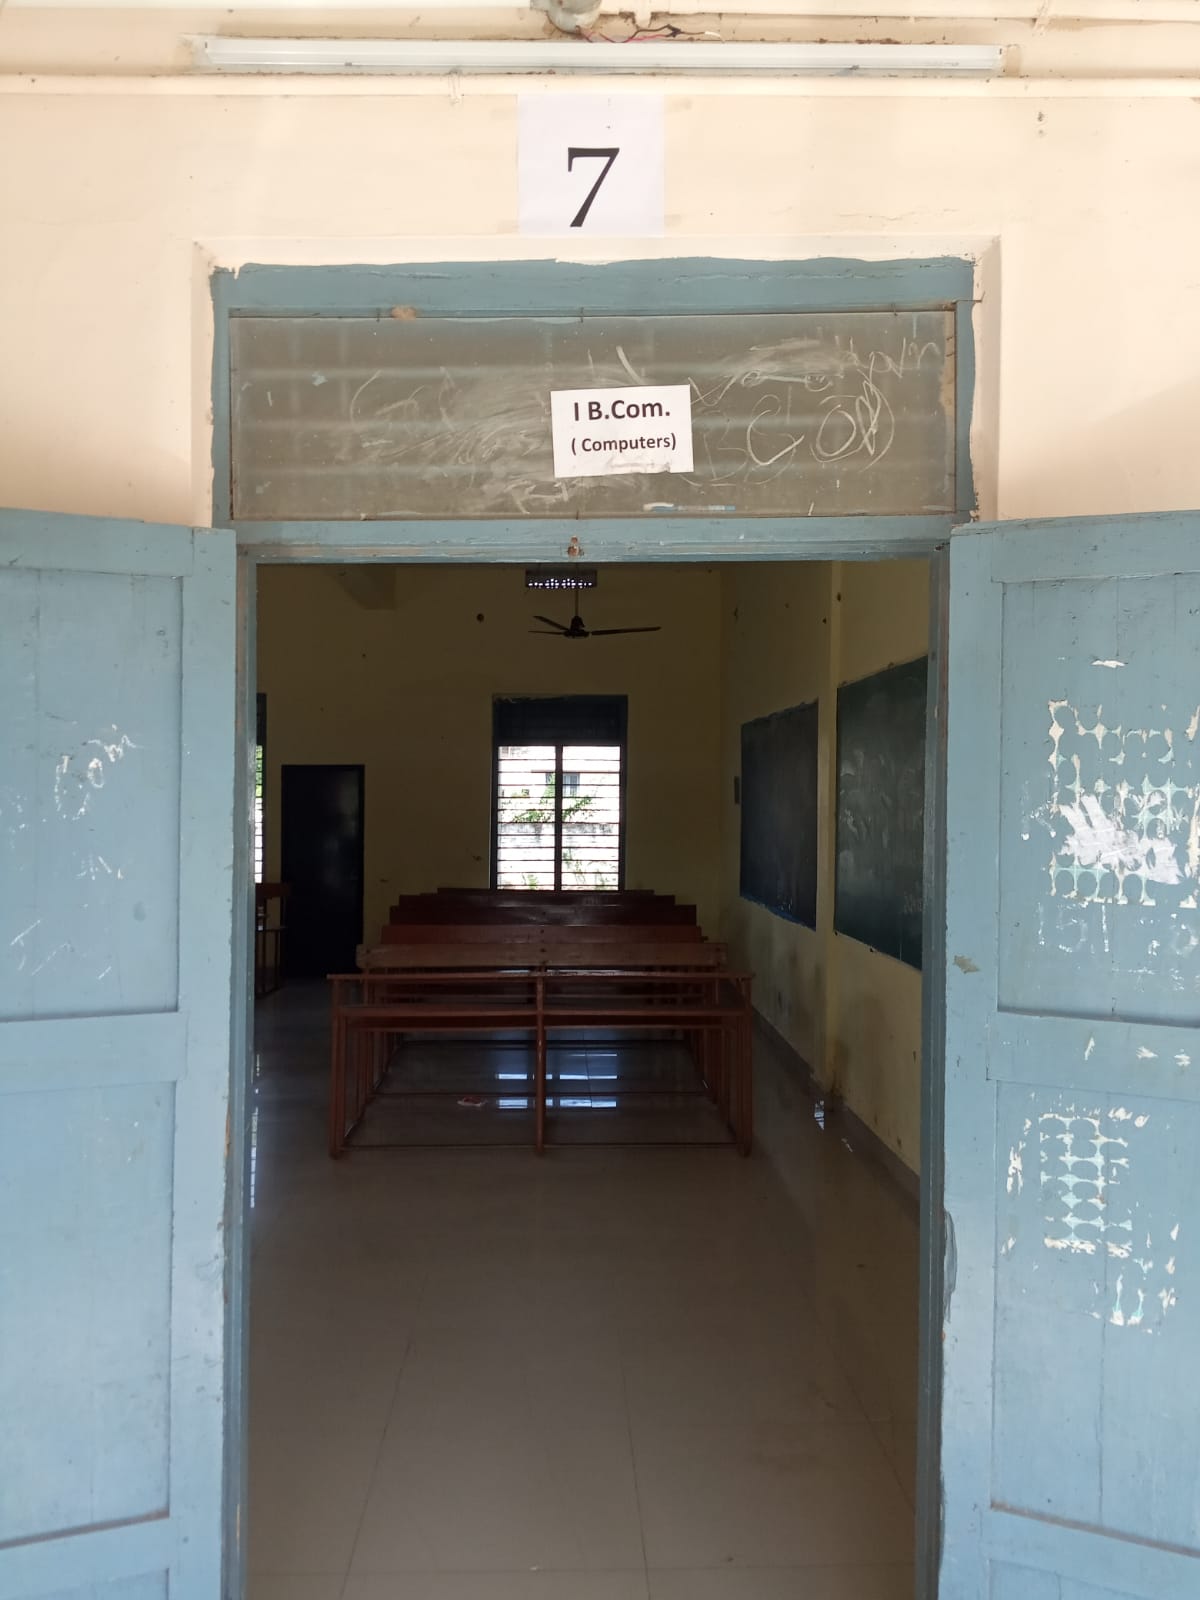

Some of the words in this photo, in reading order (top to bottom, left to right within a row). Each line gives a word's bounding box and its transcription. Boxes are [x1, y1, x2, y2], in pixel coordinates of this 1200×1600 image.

[567, 147, 620, 228] 7
[573, 402, 580, 422] I
[587, 400, 671, 421] B.Com.
